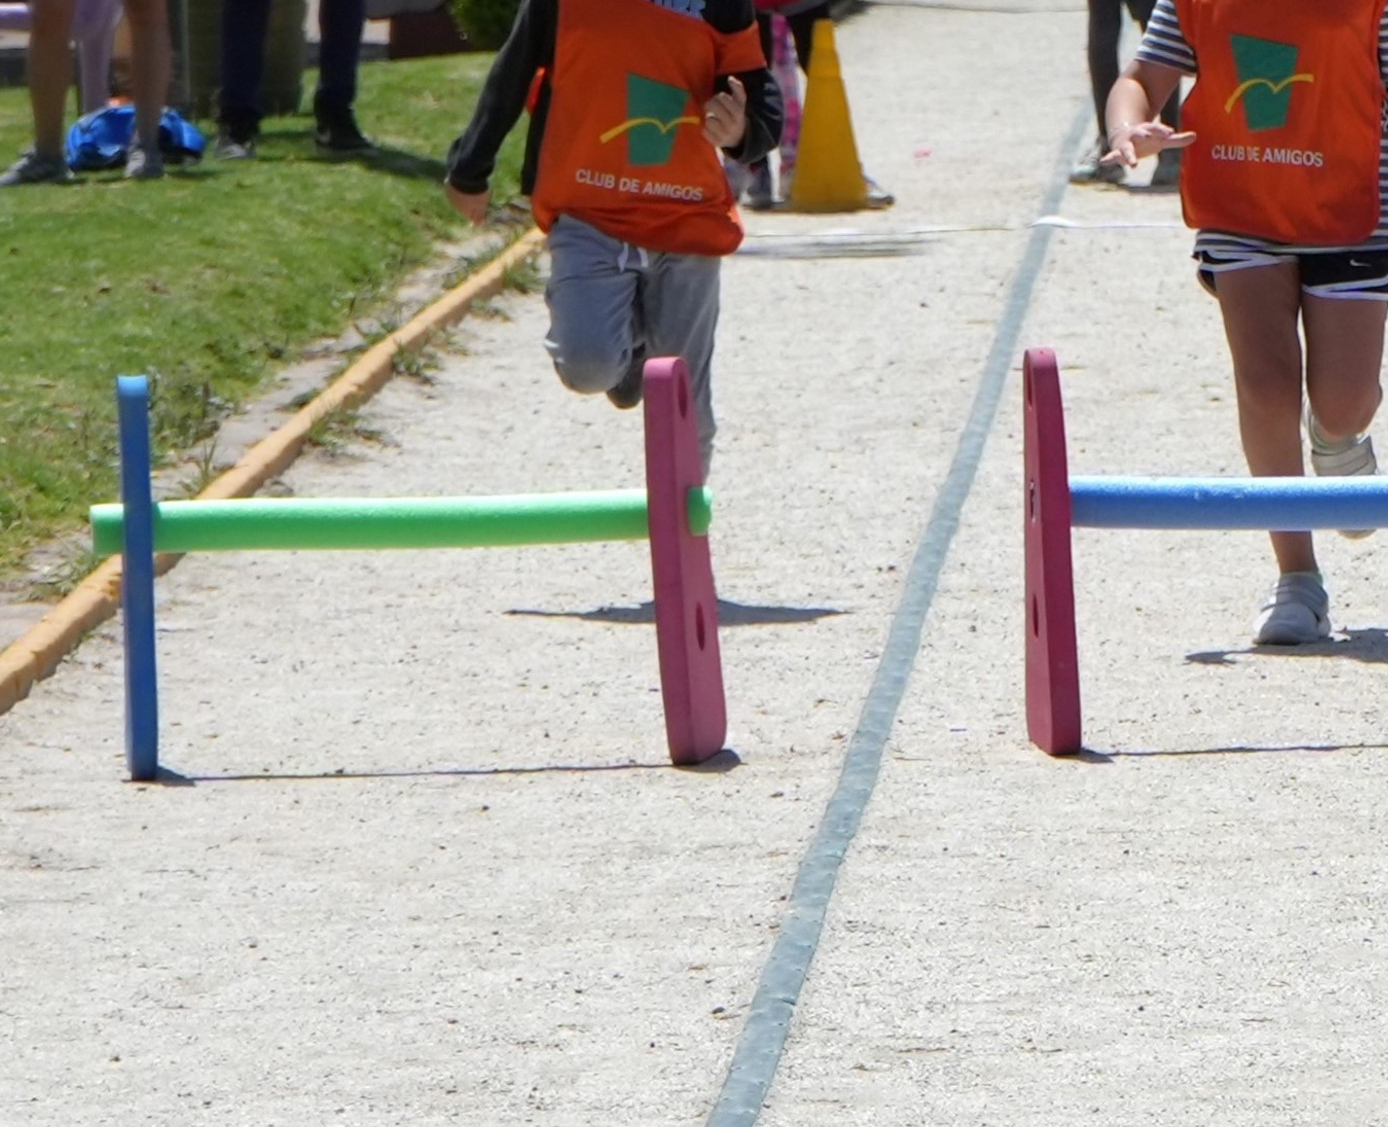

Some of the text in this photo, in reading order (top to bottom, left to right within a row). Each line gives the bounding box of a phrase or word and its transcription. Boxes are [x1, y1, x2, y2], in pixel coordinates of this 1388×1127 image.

[1211, 145, 1324, 168] CLUB DE AMIGOS
[576, 168, 704, 201] CLUB DE AMIGOS
